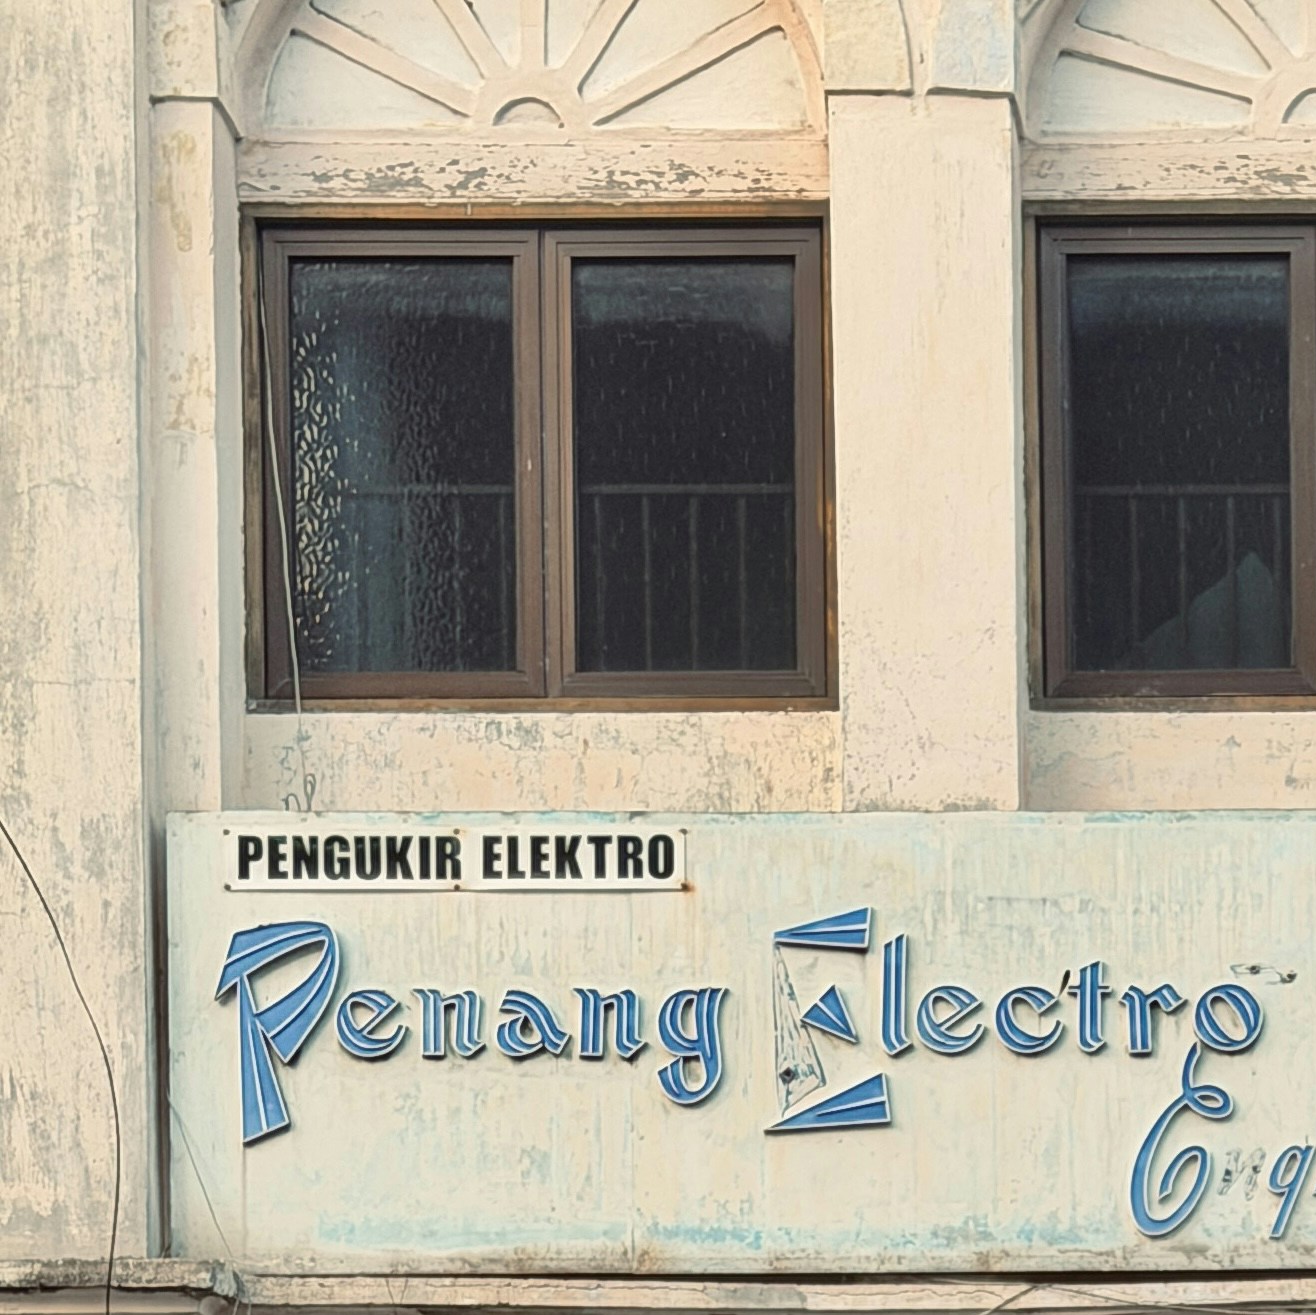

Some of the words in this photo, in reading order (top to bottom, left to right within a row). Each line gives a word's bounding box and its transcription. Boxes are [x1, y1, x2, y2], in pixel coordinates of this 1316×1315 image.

[237, 834, 463, 881] PENGUKIR
[481, 834, 676, 881] ELEKTRO
[215, 920, 731, 1146] Penang
[764, 907, 1265, 1134] Electro
